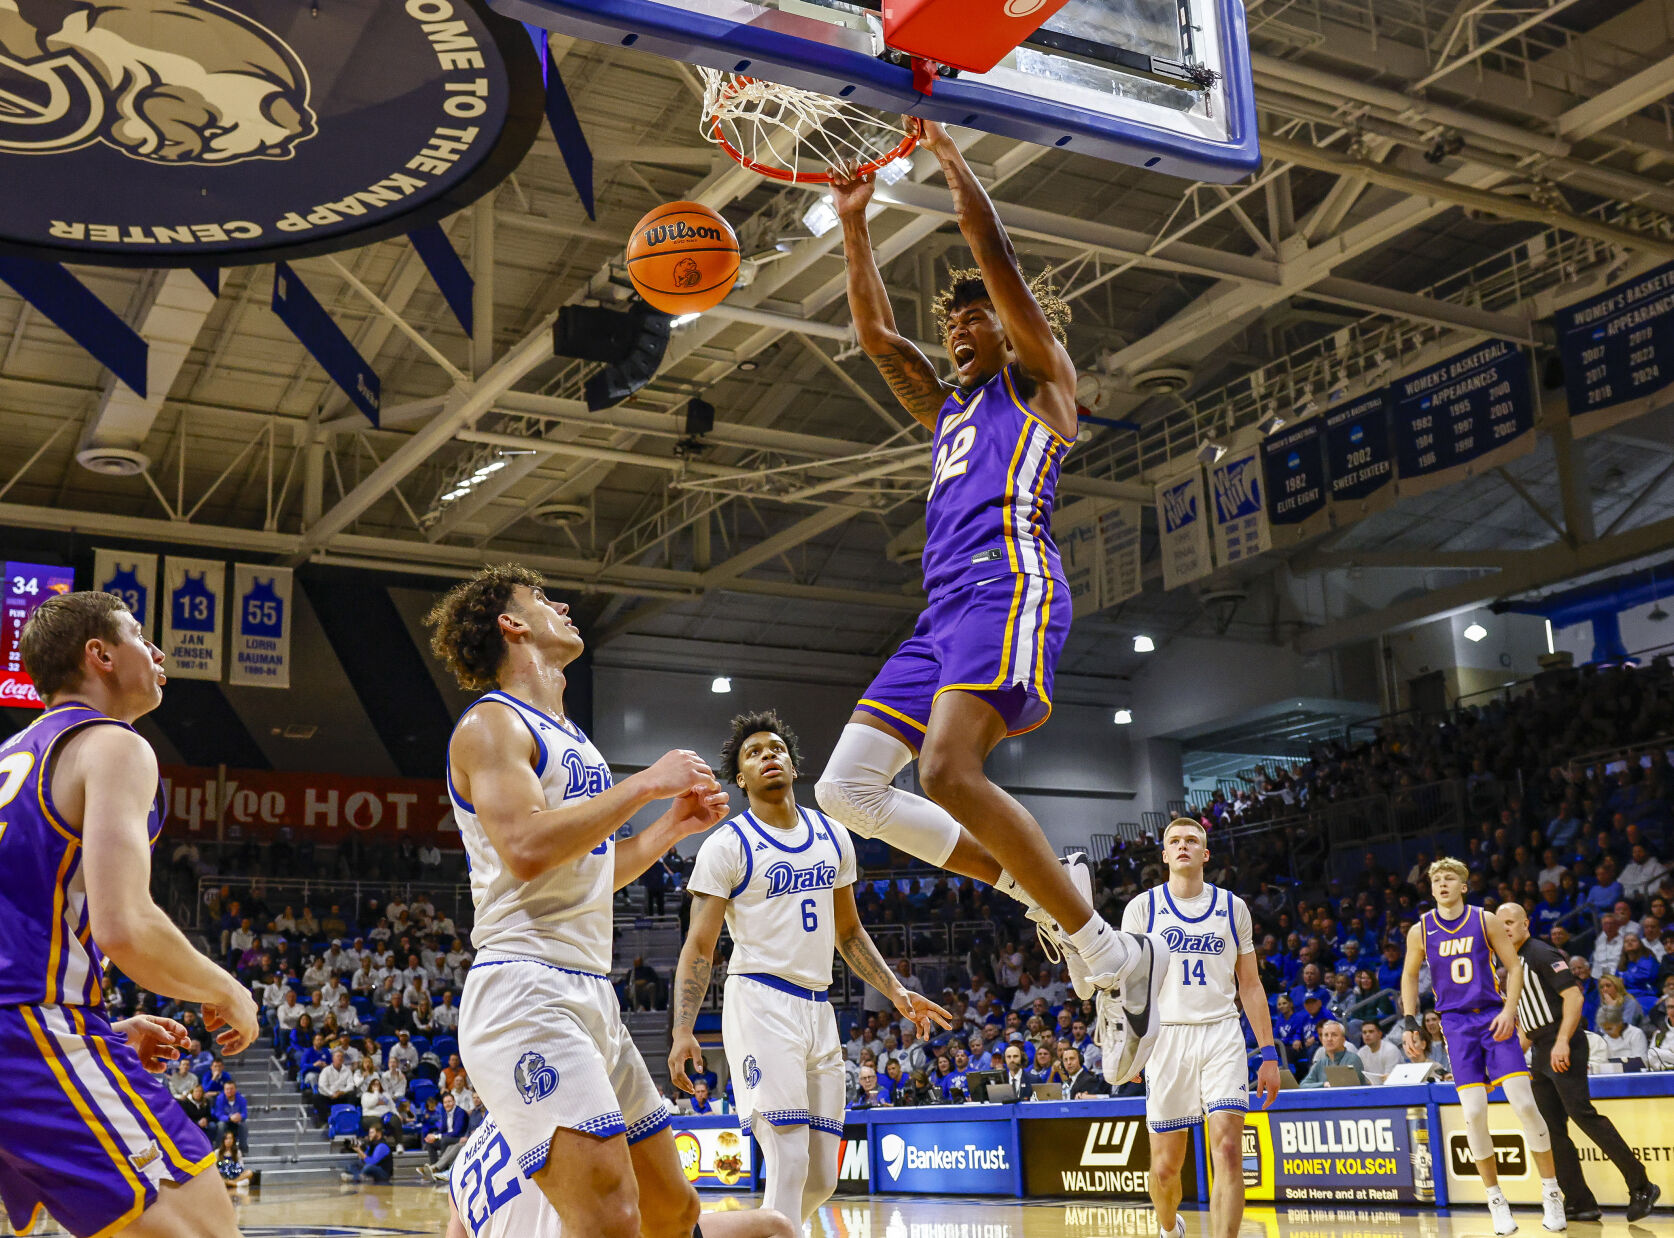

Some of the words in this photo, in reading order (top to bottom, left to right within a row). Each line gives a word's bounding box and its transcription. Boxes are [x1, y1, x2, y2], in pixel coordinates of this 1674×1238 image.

[443, 78, 488, 118] TO
[405, 126, 480, 175] THE
[276, 172, 427, 232] KNAPP
[49, 220, 263, 244] CENTER
[644, 221, 723, 247] Wilson
[1574, 294, 1625, 325] WOMEN'S
[1405, 368, 1448, 396] WOMEN'S
[1449, 342, 1507, 377] BASKETBALL
[1432, 367, 1498, 407] APPEARANCES
[1412, 415, 1433, 431] 1982
[1449, 399, 1471, 417] 1995
[1453, 418, 1473, 435] 1997
[1347, 446, 1371, 469] 2002
[1285, 473, 1306, 492] 1982
[1332, 472, 1357, 491] SWEET
[1359, 461, 1390, 481] SIXTEEN
[1277, 498, 1297, 514] ELITE
[1298, 488, 1319, 506] EIGHT
[12, 576, 39, 596] 34
[179, 595, 208, 619] 13
[247, 600, 278, 626] 55
[13, 619, 21, 628] 0
[14, 629, 20, 639] 1
[12, 640, 19, 650] 7
[181, 633, 205, 645] JAN
[246, 639, 277, 651] LORRI
[9, 651, 21, 662] 22
[172, 646, 214, 660] JENSEN
[238, 651, 283, 666] BAUMAN
[8, 662, 21, 672] 32
[304, 788, 418, 830] HOT
[764, 859, 837, 899] Drake
[800, 898, 818, 933] 6
[1160, 925, 1226, 956] Drake
[1438, 936, 1474, 957] UNI
[1182, 958, 1207, 986] 14
[1450, 957, 1474, 985] 0
[1279, 1119, 1395, 1153] BULLDOG
[907, 1145, 964, 1169] Bankers
[964, 1144, 1010, 1170] Trust.
[1283, 1159, 1331, 1175] HONEY
[1336, 1158, 1397, 1175] KOLSCH
[1456, 1147, 1521, 1164] WTZ
[1633, 1147, 1674, 1161] BETT
[460, 1131, 522, 1238] 22
[1286, 1188, 1307, 1199] Sold
[1309, 1188, 1333, 1200] Here
[1335, 1189, 1353, 1200] and
[1356, 1190, 1367, 1200] at
[1369, 1189, 1399, 1201] Retail
